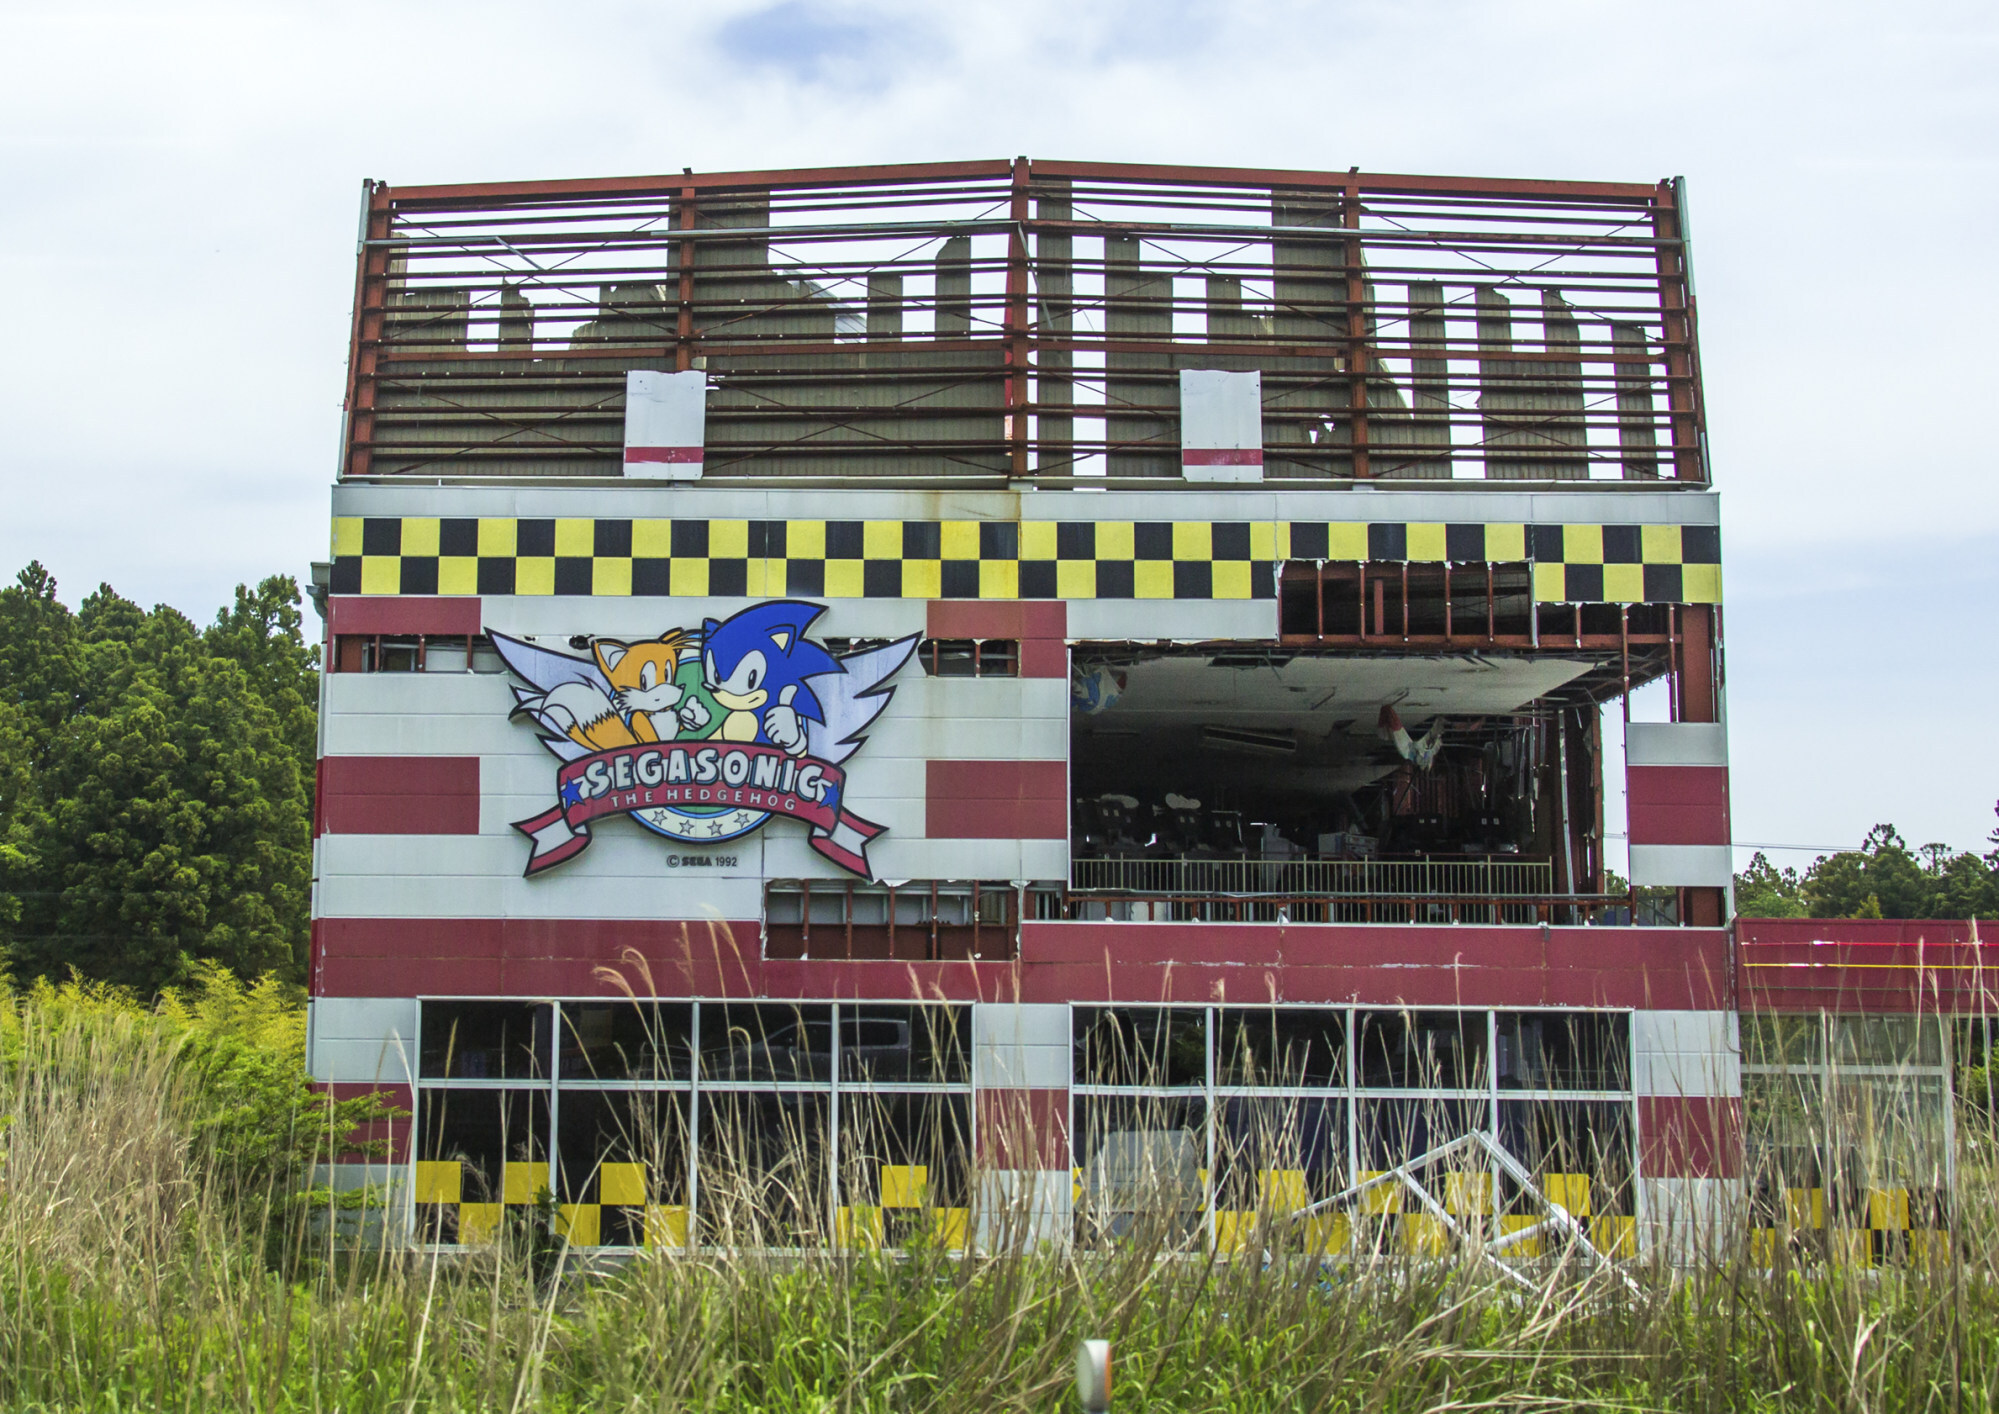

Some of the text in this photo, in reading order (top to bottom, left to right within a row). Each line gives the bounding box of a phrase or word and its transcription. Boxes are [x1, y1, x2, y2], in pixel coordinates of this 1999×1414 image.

[584, 748, 824, 802] SEGASONIC
[611, 788, 796, 811] THE HEDGEHOG
[681, 856, 712, 867] SEGA
[715, 856, 737, 867] 1992
